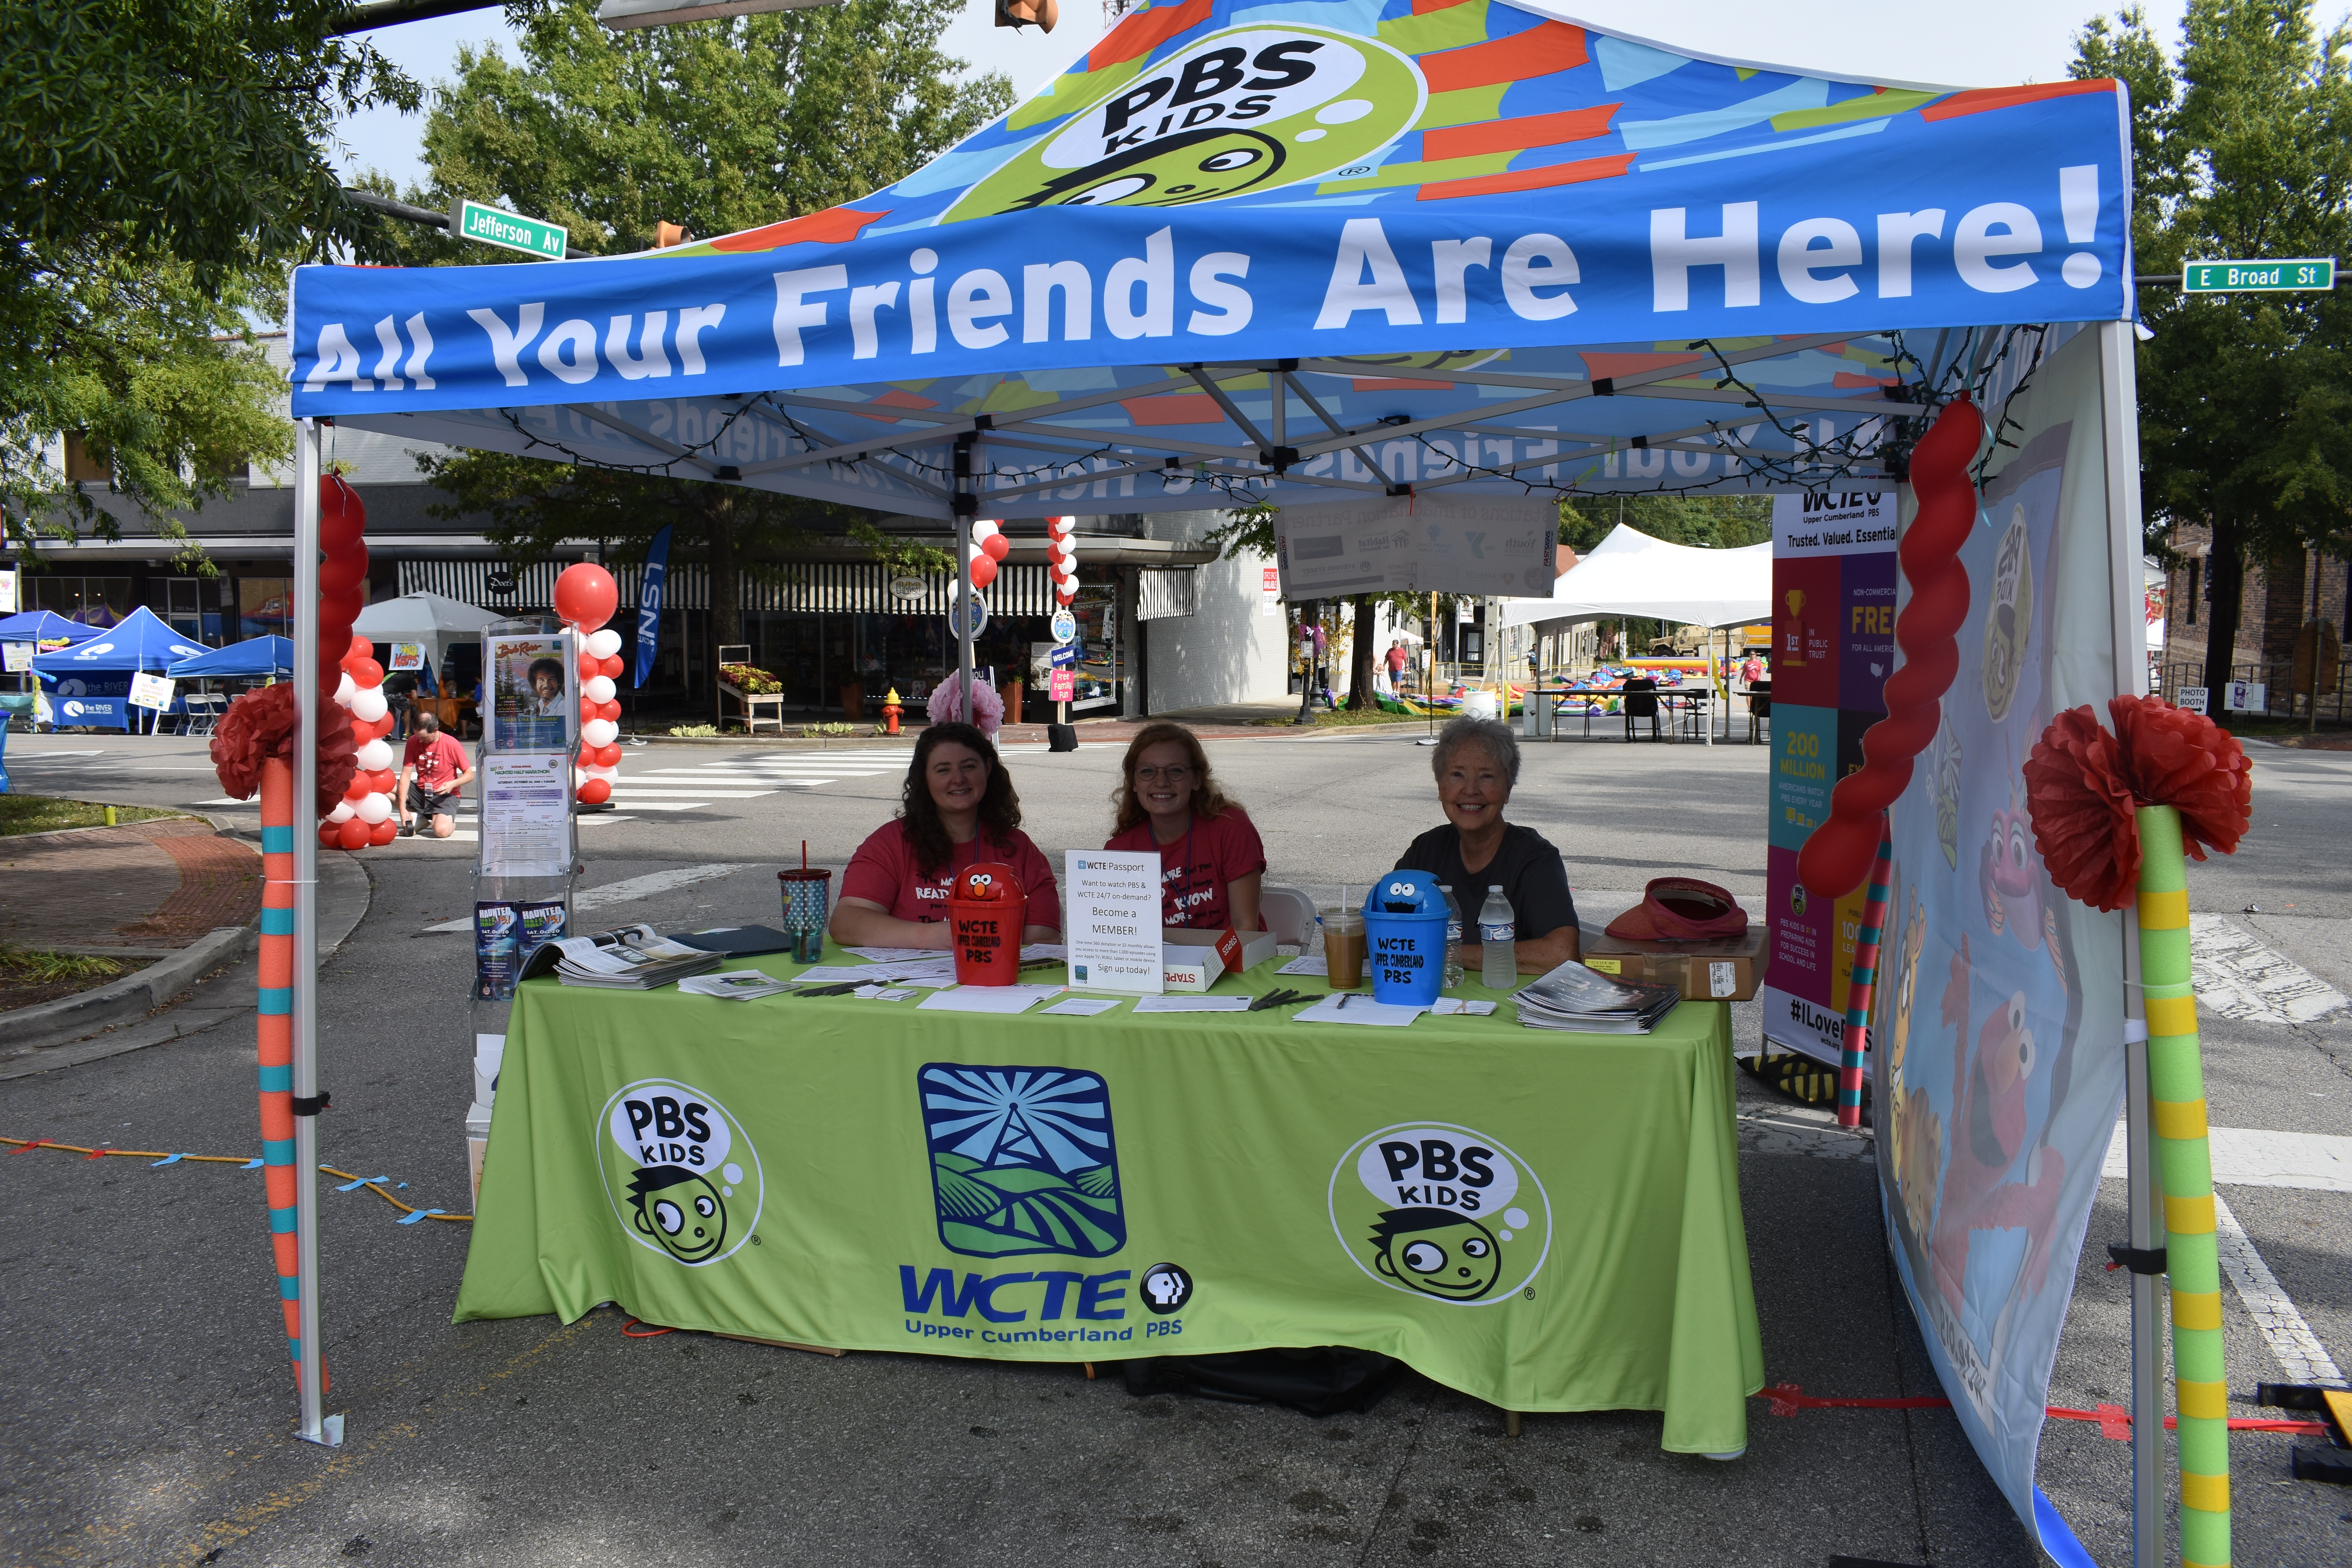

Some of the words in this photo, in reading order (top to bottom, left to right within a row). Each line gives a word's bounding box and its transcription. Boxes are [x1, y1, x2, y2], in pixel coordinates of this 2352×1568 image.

[1102, 40, 1326, 138] PBS
[1104, 94, 1277, 156] KIDS
[470, 212, 531, 245] Jefferson
[543, 231, 559, 252] Av
[303, 312, 436, 392] All
[467, 303, 726, 388] Your
[773, 225, 1252, 367] Friends
[1314, 218, 1581, 330] Are
[1650, 165, 2103, 312] Here!
[2201, 269, 2210, 286] E
[2228, 268, 2279, 285] Broad
[2297, 267, 2316, 284] St
[1804, 516, 1822, 524] Upper
[1824, 511, 1864, 521] Cumberland
[1868, 508, 1879, 517] PBS
[1788, 533, 1820, 547] Trusted.
[1823, 530, 1853, 545] Valued.
[490, 577, 513, 589] Poet's
[639, 563, 663, 638] LSN
[1852, 606, 1896, 634] FRE
[498, 644, 519, 658] Bob
[519, 642, 542, 656] Ross
[1053, 650, 1074, 662] WELCOME
[88, 683, 101, 691] the
[105, 682, 129, 691] RIVER
[1054, 682, 1072, 690] Family
[1787, 731, 1818, 758] 200
[1780, 757, 1825, 780] MILLION
[1779, 782, 1806, 793] AMERICANS
[1808, 787, 1824, 797] WATCH
[1781, 793, 1790, 802] PBS
[1792, 796, 1807, 805] EVERY
[1809, 799, 1822, 808] YEAR
[1087, 862, 1106, 870] WCTE
[1109, 862, 1145, 873] Passport
[1198, 863, 1212, 873] you
[1192, 879, 1213, 888] things
[1795, 886, 1803, 895] PBS
[1096, 891, 1111, 900] 24/7
[1112, 893, 1151, 901] on-demand?
[479, 907, 511, 921] HAUNTED
[522, 906, 561, 921] HAUNTED
[1093, 907, 1129, 917] Become
[480, 917, 496, 927] HALF
[498, 915, 511, 925] 13.1
[523, 917, 543, 928] HALF
[546, 915, 562, 925] 13.1
[958, 920, 998, 934] WCTE
[1780, 918, 1789, 927] PBS
[1789, 920, 1799, 931] KIDS
[1800, 924, 1805, 932] IS
[1812, 928, 1817, 936] IN
[1093, 924, 1137, 935] MEMBER!
[958, 935, 970, 947] UPPER
[971, 934, 1001, 948] CUMBERLAND
[1222, 935, 1237, 956] STAPLES
[1377, 938, 1415, 951] WCTE
[1781, 929, 1804, 944] PREPARING
[1805, 937, 1815, 947] KIDS
[966, 949, 993, 963] PBS
[1780, 941, 1789, 950] FOR
[1790, 944, 1809, 957] SUCCESS
[1810, 950, 1815, 959] IN
[1374, 952, 1389, 967] UPPER
[1390, 953, 1424, 969] CUMBERLAND
[1779, 952, 1795, 964] SCHOOL
[1797, 957, 1806, 967] AND
[1807, 961, 1816, 971] LIFE
[1098, 964, 1112, 973] Sign
[1127, 966, 1150, 976] today!
[1164, 972, 1195, 983] STAPL
[1384, 970, 1411, 984] PBS
[1821, 1037, 1840, 1051] wcte.org
[624, 1096, 711, 1143] PBS
[640, 1143, 705, 1165] KIDS
[1378, 1139, 1494, 1187] PBS
[1397, 1185, 1481, 1210] KIDS
[899, 1265, 1131, 1323] WCTE
[906, 1319, 974, 1339] Upper
[982, 1326, 1132, 1343] Cumberland
[1147, 1320, 1183, 1338] PBS
